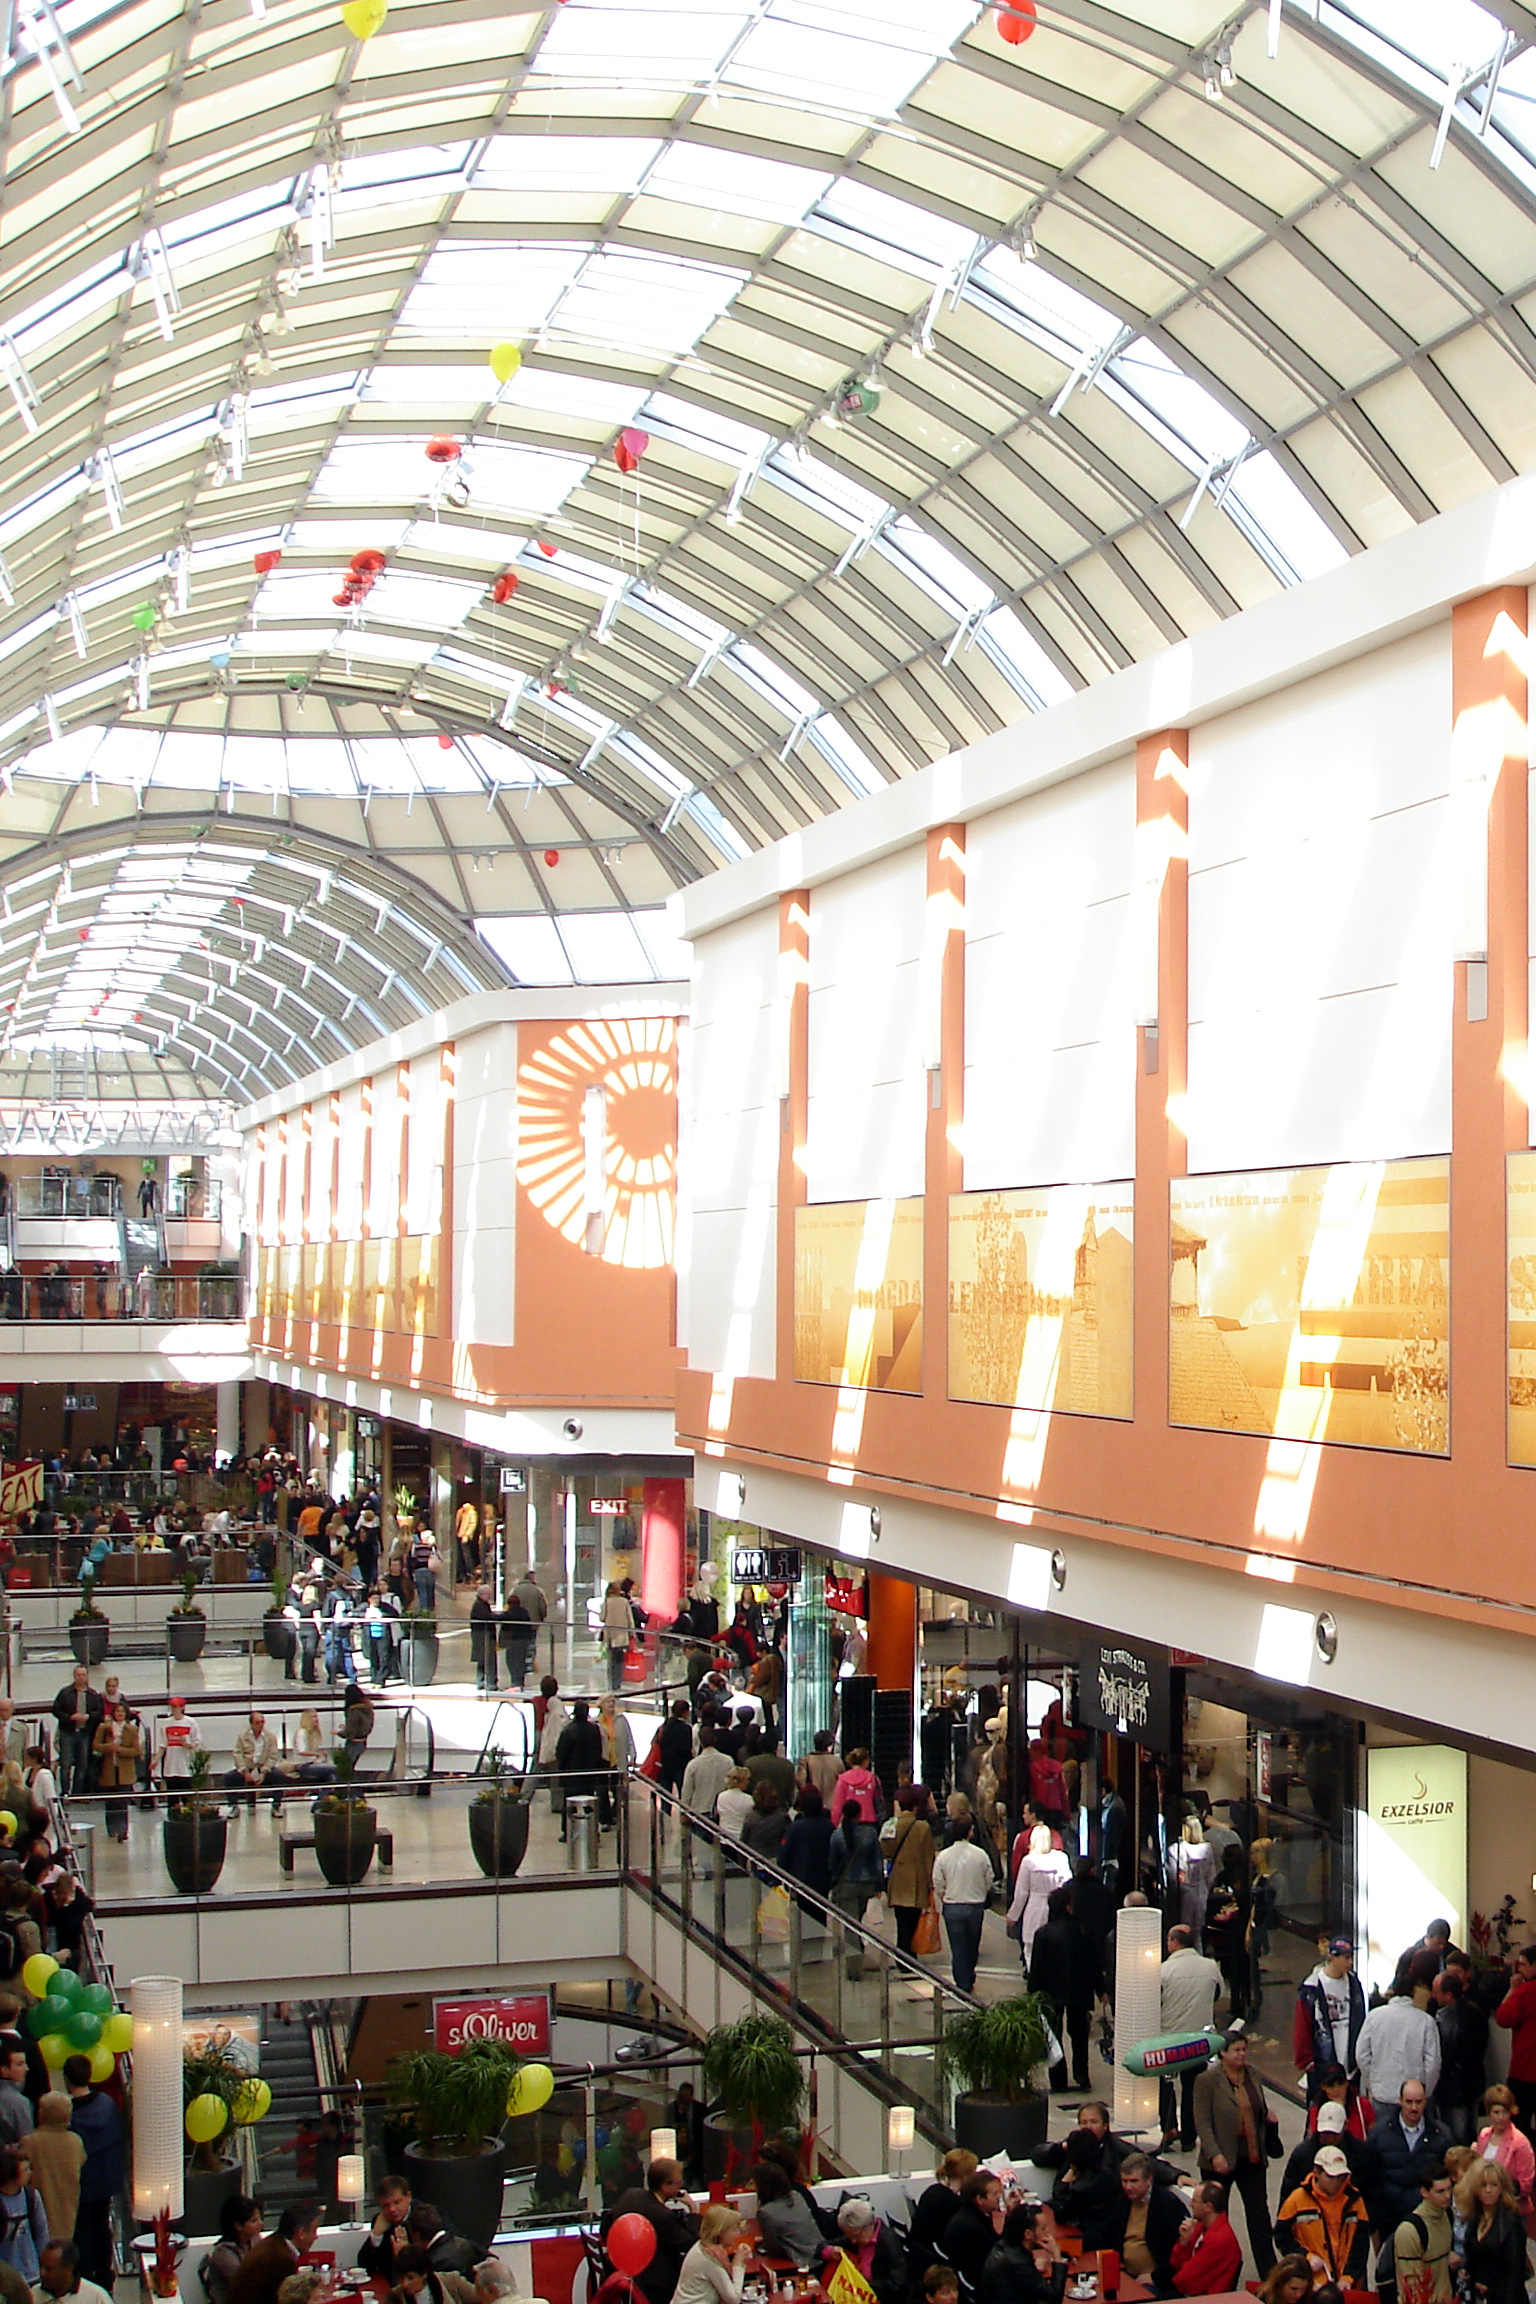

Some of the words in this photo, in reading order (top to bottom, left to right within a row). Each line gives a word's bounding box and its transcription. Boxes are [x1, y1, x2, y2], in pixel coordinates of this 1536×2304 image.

[590, 1499, 628, 1514] EXIT
[1381, 1802, 1454, 1818] EXZELSIOR
[448, 2011, 539, 2046] s.Oliver
[1145, 2041, 1209, 2067] HUMANIC
